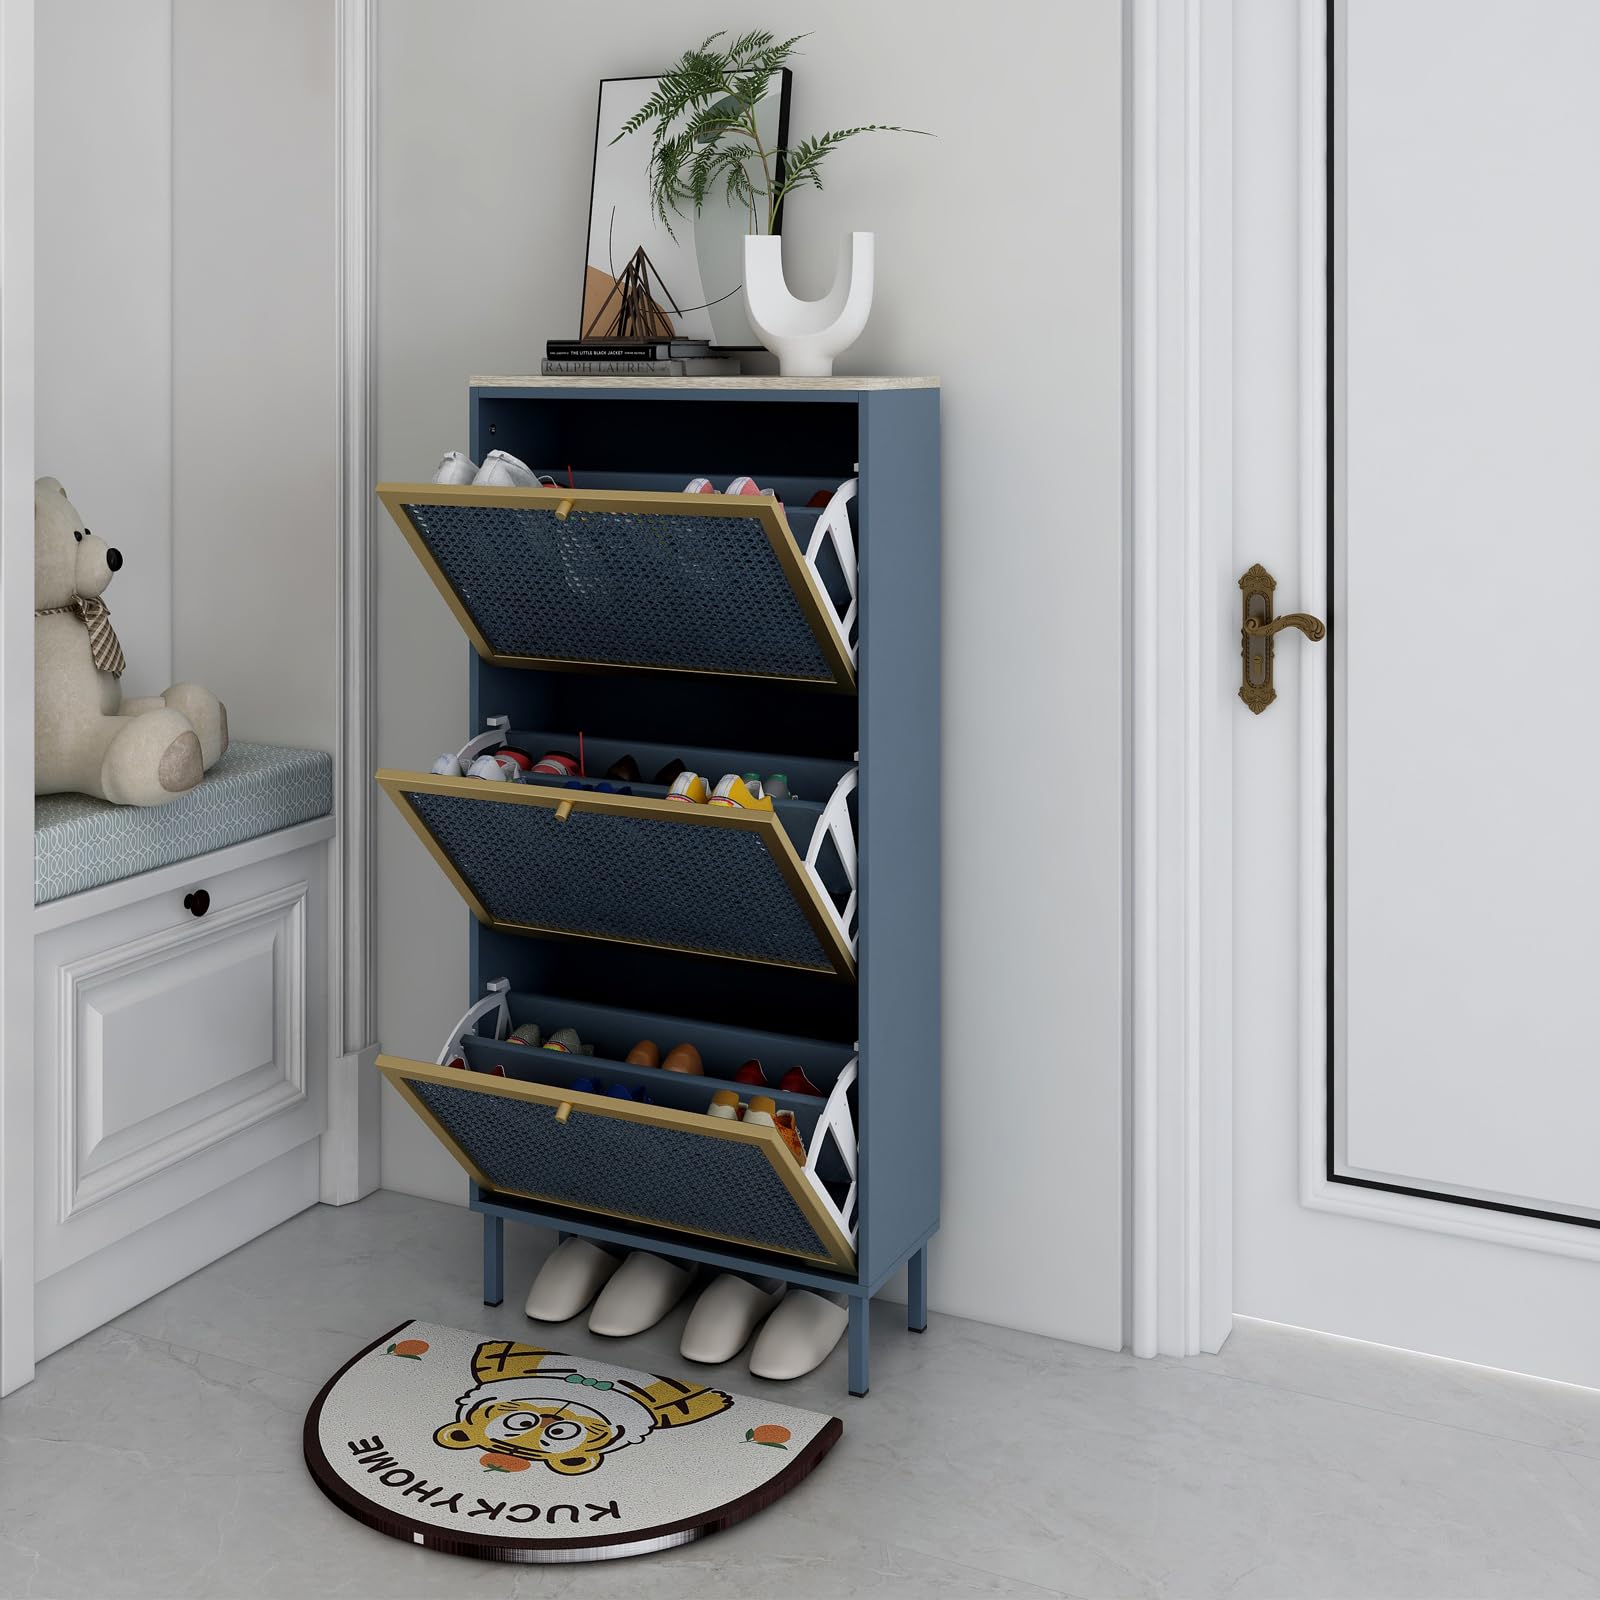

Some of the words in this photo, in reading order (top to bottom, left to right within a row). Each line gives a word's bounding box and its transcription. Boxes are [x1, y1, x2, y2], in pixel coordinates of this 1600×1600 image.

[545, 362, 592, 372] RALPH
[598, 362, 656, 373] LAUREN
[347, 1435, 621, 1524] KUCKYHOME
